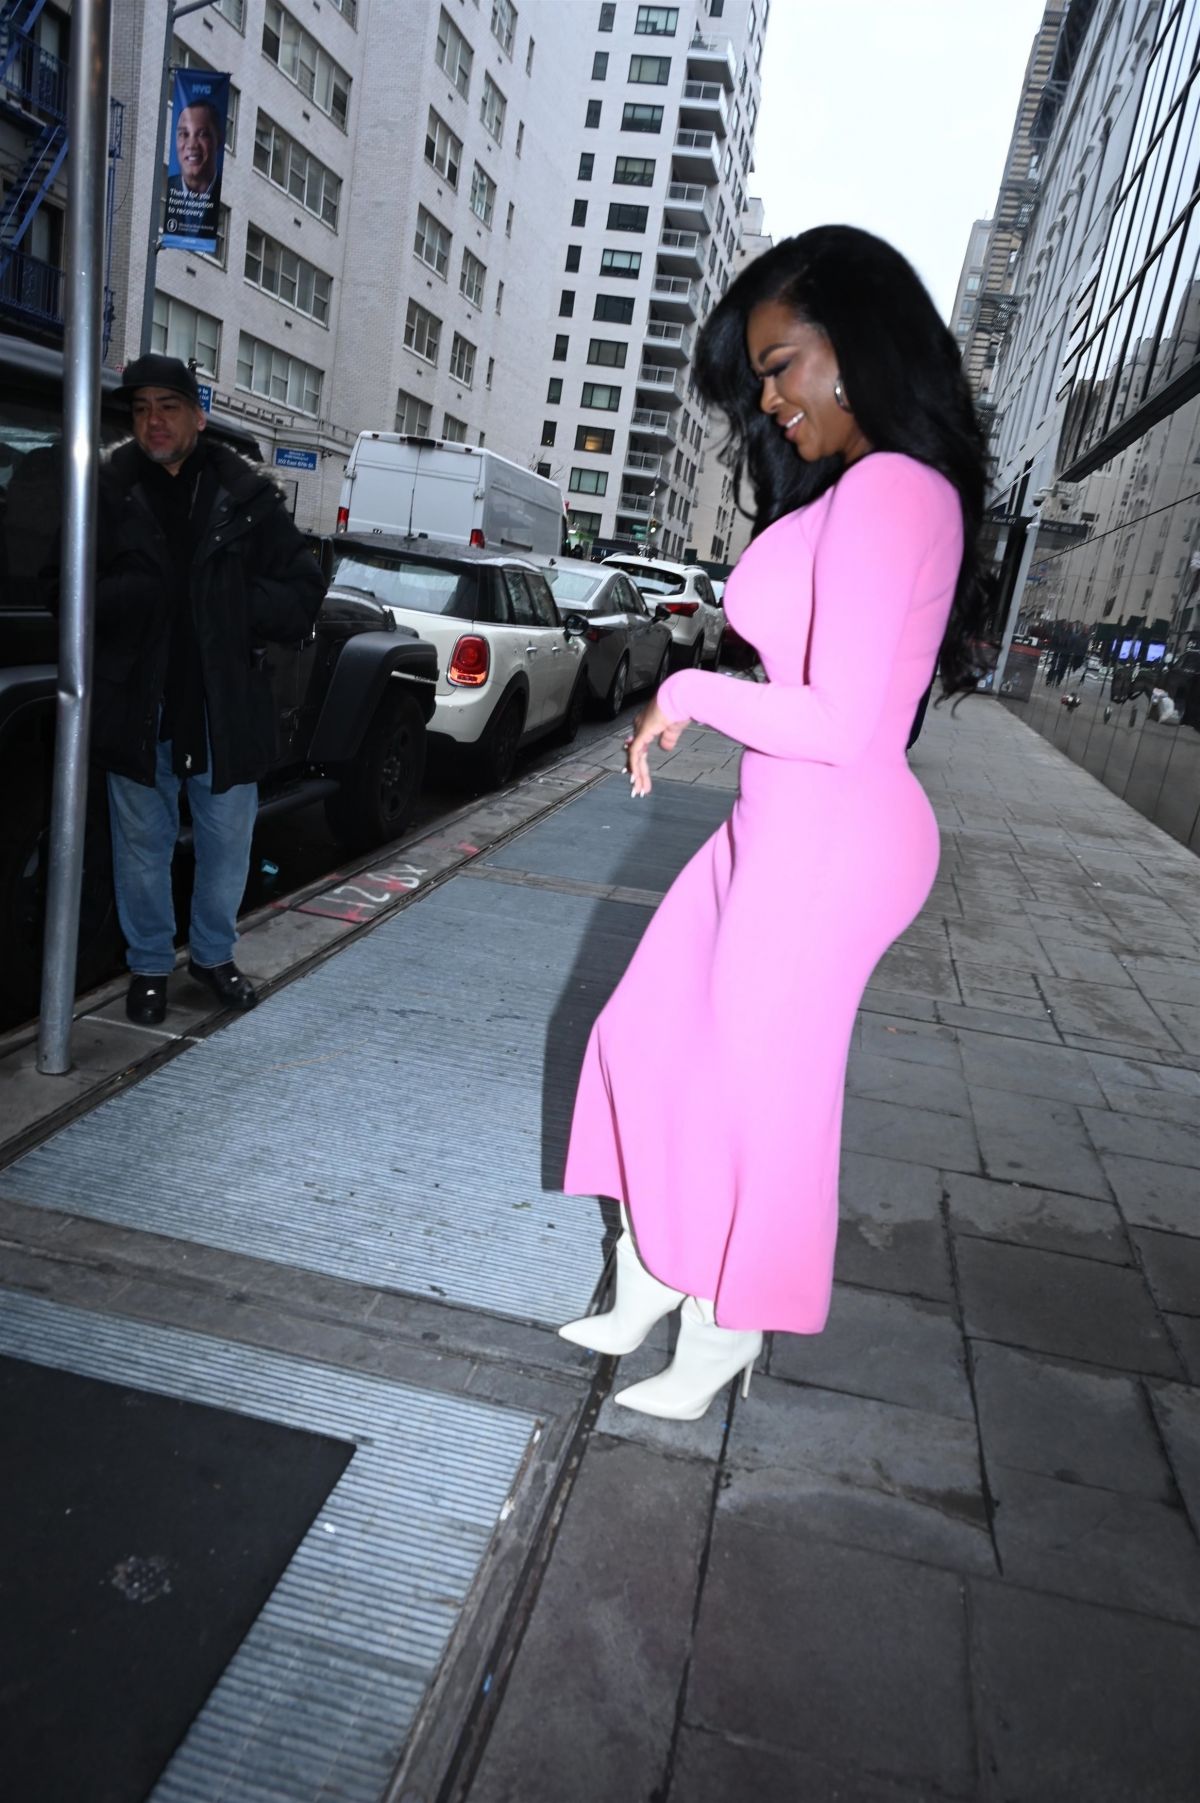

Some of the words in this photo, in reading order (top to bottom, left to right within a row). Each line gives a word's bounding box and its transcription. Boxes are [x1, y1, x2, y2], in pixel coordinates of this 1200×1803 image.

[170, 188, 188, 198] There
[189, 190, 198, 198] for
[199, 192, 210, 200] you
[169, 197, 184, 205] from
[185, 199, 214, 208] reception
